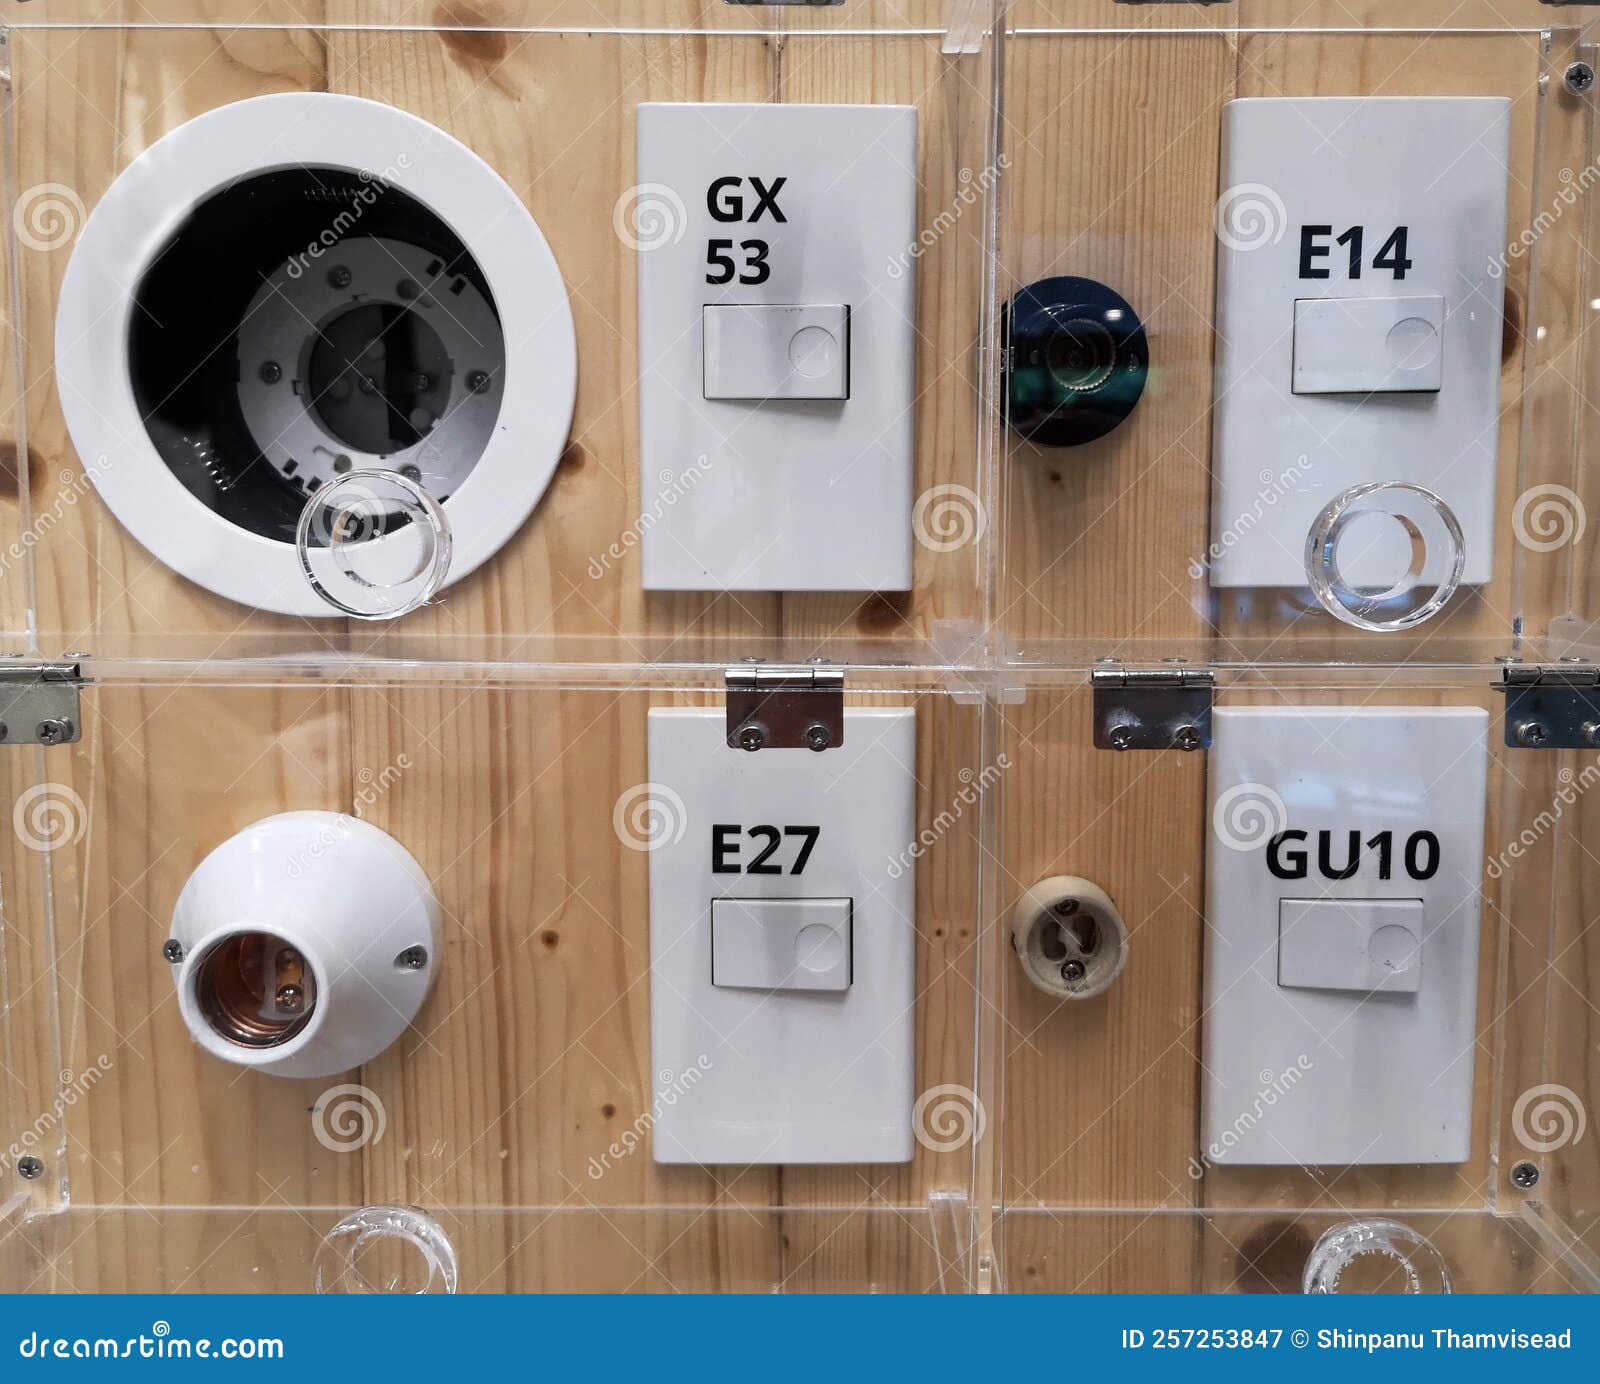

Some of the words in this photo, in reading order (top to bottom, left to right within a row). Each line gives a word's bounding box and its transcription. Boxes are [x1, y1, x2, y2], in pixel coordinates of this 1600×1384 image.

[706, 175, 788, 224] GX
[705, 238, 771, 286] 53
[1298, 224, 1413, 281] E14
[711, 824, 821, 876] E27
[1265, 829, 1441, 881] GU10
